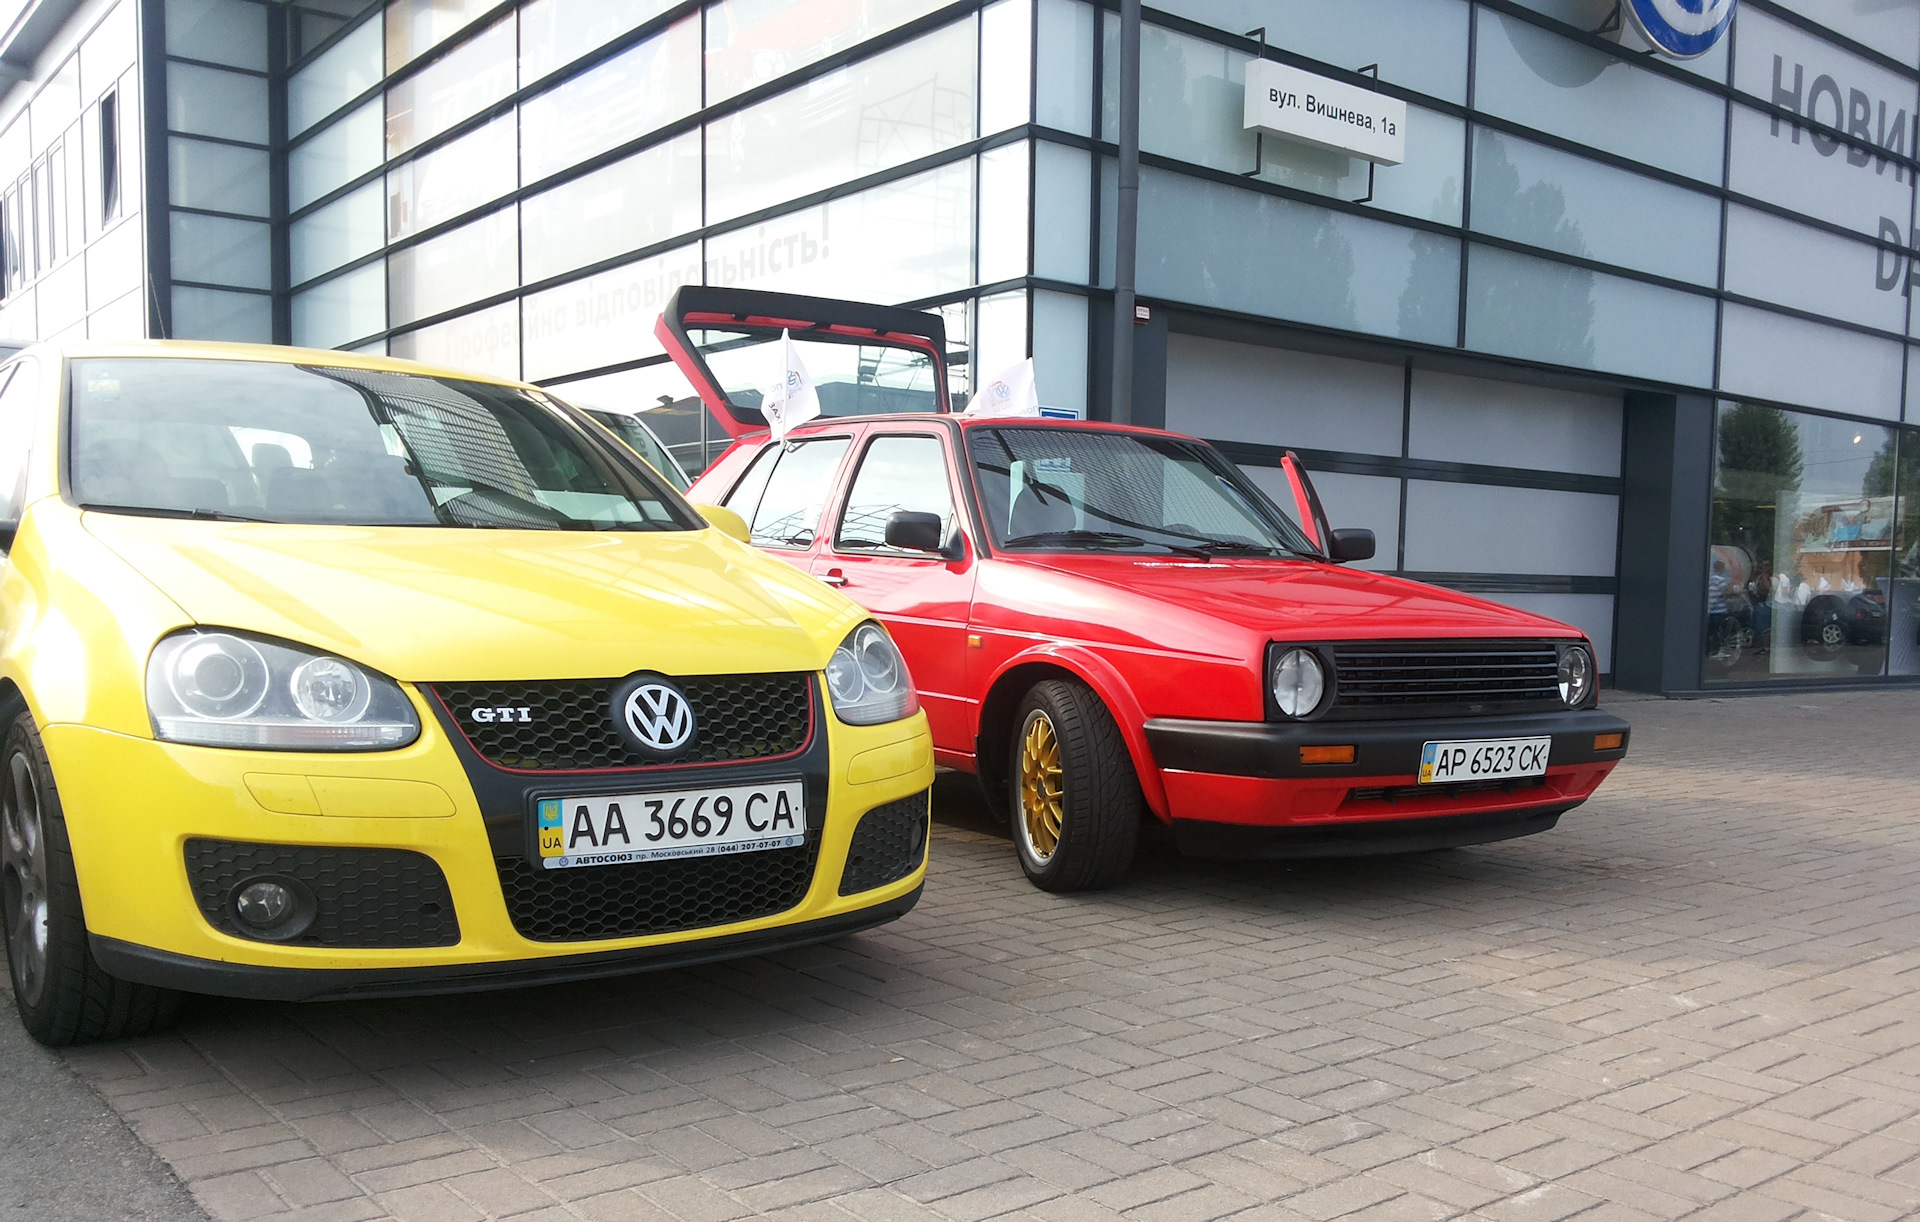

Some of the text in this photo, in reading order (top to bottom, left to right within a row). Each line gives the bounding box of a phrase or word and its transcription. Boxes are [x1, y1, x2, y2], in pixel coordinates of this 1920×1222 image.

[1269, 88, 1396, 136] вул. Вишнева, 1а
[1770, 53, 1914, 188] НОВИ
[446, 295, 567, 368] Професйна
[471, 707, 532, 722] GTI
[1435, 743, 1546, 777] AP 6523 CK
[569, 790, 795, 849] AA 3669 CA
[542, 837, 562, 849] UA
[575, 853, 633, 865] АВТОСОЮЗ
[636, 853, 648, 861] пр.
[651, 847, 703, 858] Московський
[717, 843, 738, 853] (044)
[741, 840, 781, 850] 207-07-07
